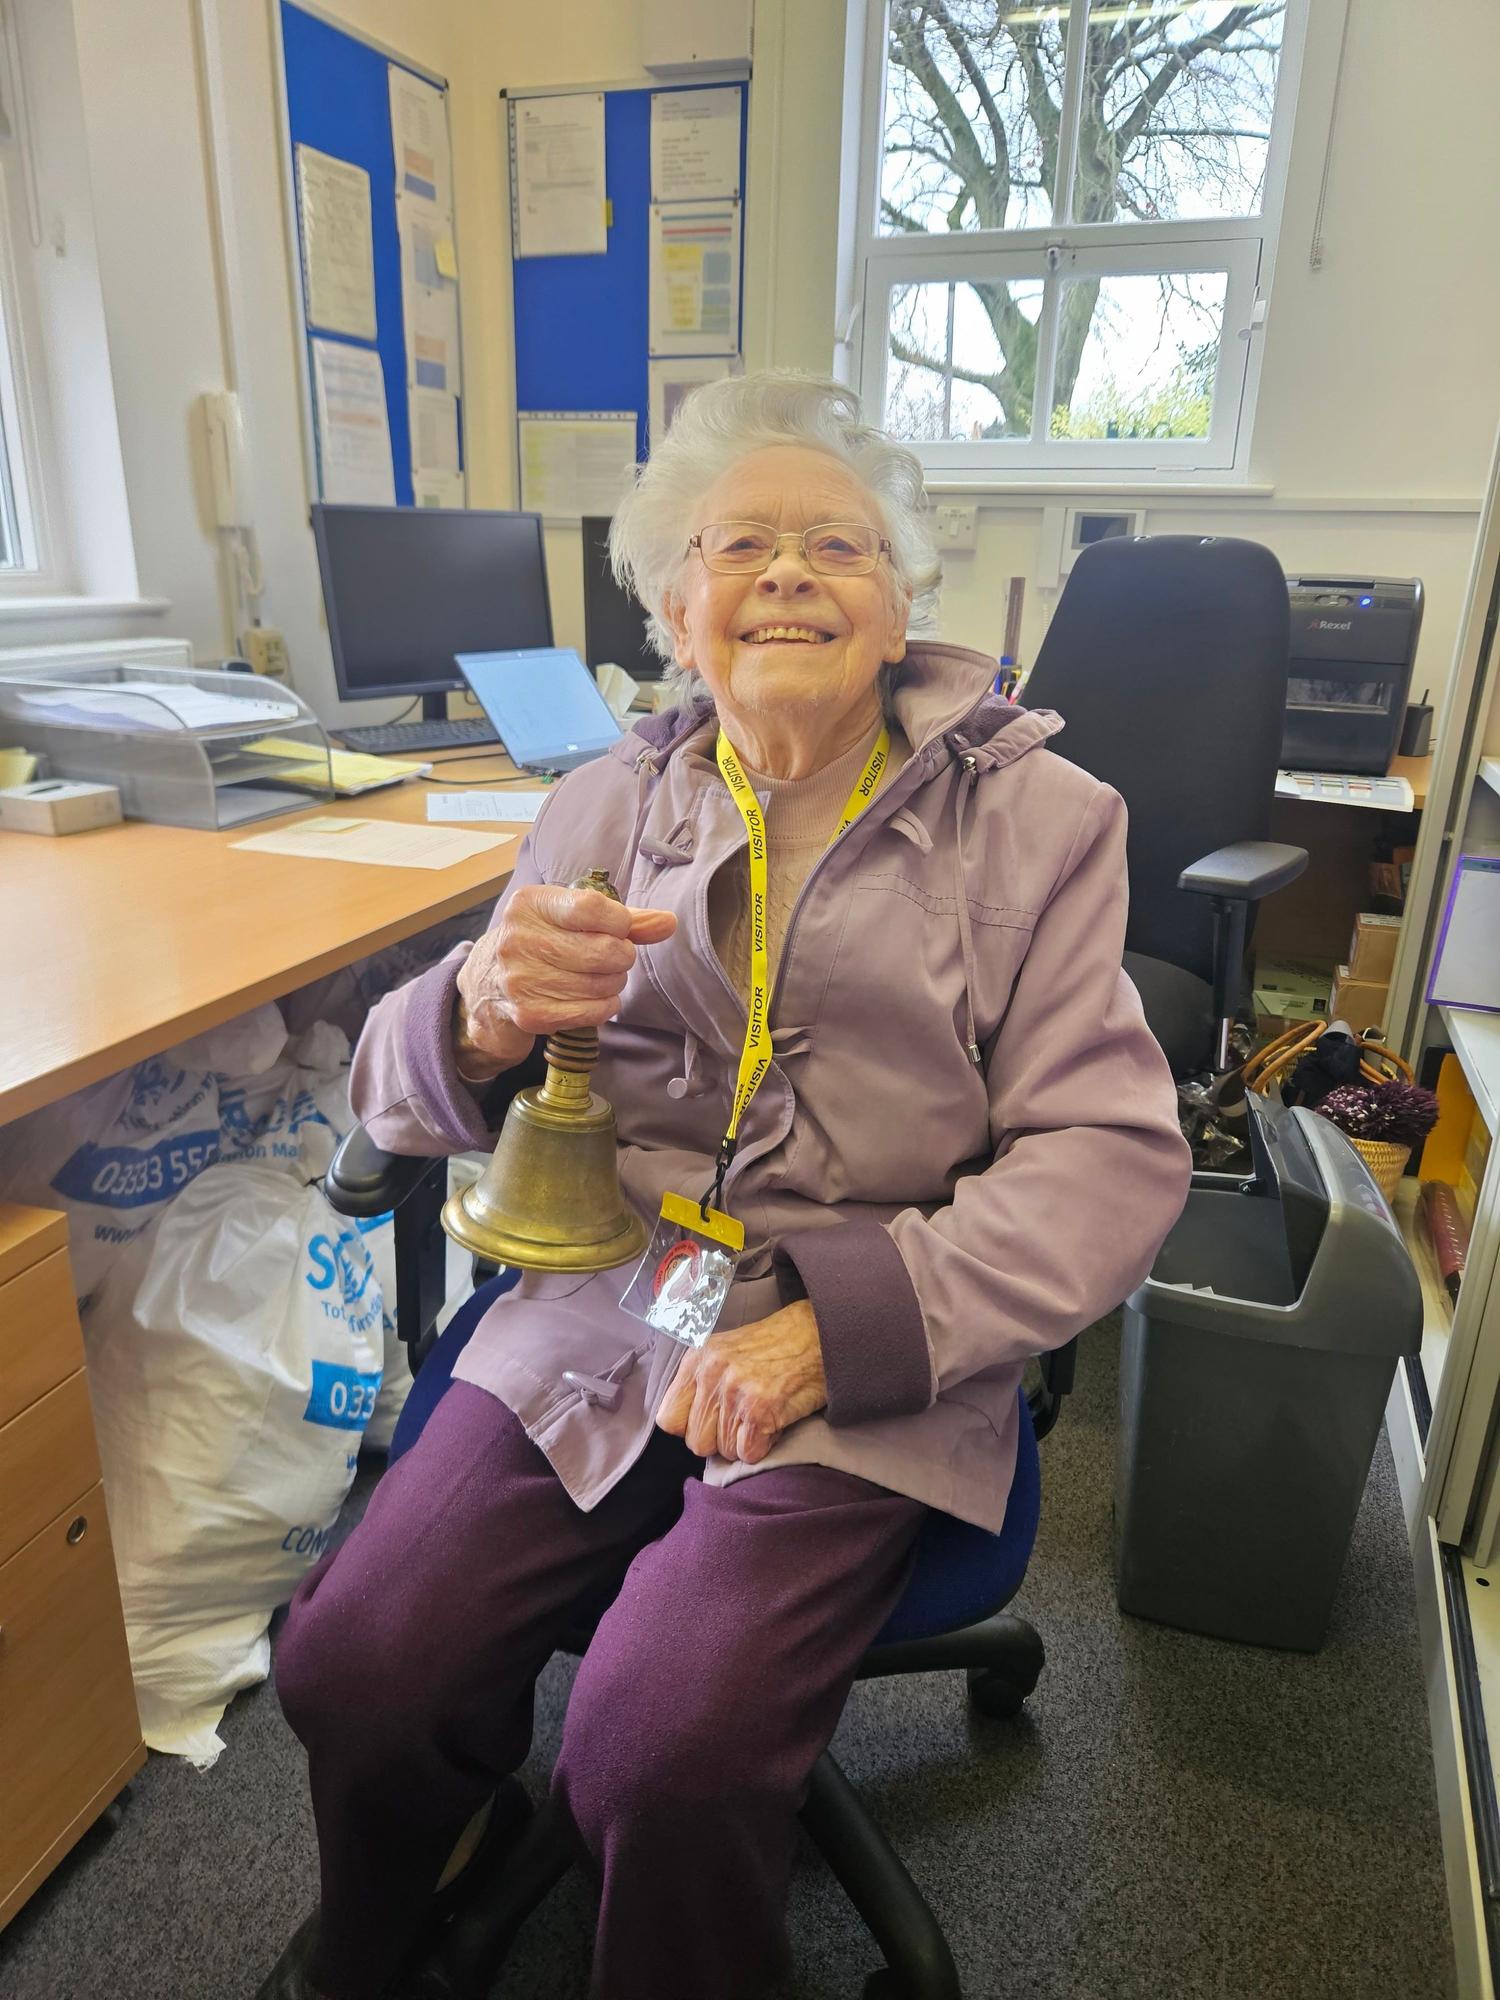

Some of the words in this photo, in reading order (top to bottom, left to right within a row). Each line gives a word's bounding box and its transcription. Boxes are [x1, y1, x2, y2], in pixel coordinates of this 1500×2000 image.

[1319, 620, 1352, 631] Rexel
[722, 755, 746, 792] VISITOR
[859, 751, 886, 797] VISITOR
[746, 809, 763, 860] VISITOR
[755, 892, 763, 952] VISITOR
[749, 986, 763, 1048] VISITOR
